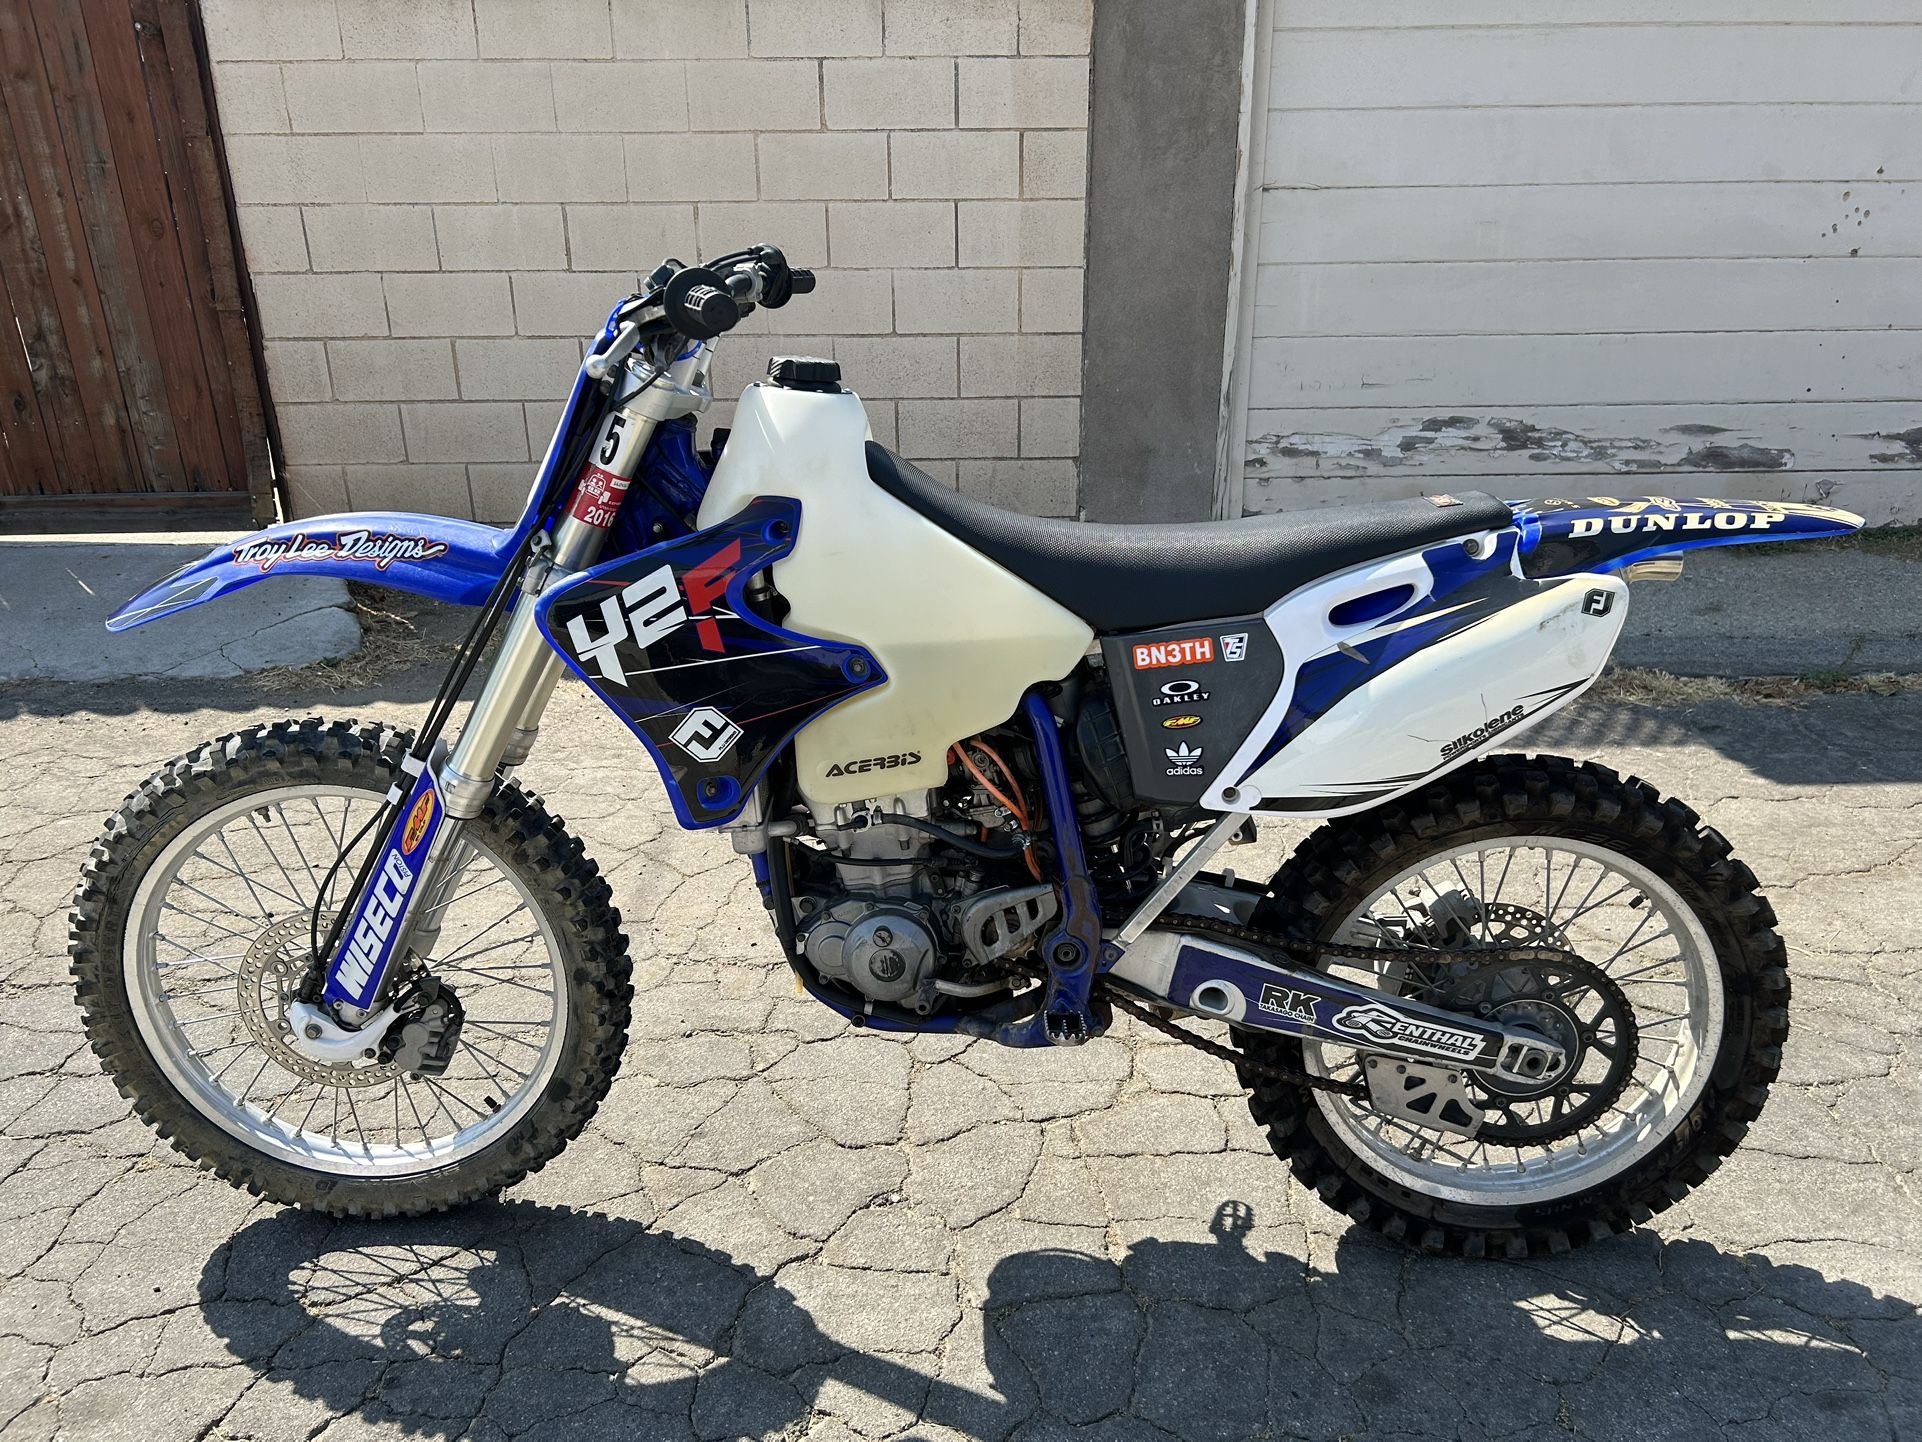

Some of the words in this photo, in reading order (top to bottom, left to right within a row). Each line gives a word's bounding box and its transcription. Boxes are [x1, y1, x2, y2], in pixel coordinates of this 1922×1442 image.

[600, 414, 626, 466] 5
[583, 506, 616, 527] 2016
[1567, 512, 1786, 539] DUNLOP
[235, 536, 285, 570] Troy
[285, 533, 334, 560] Lee
[337, 530, 446, 569] Designs
[1135, 640, 1211, 667] BN3TH
[1152, 692, 1210, 706] OAKLEY
[1440, 704, 1524, 757] Silkolene
[1166, 765, 1204, 777] adidas
[391, 852, 412, 878] PISTON
[335, 852, 413, 1001] WISECO
[1259, 1002, 1293, 1019] TAKASAGO
[1294, 1010, 1315, 1023] CHAIN
[1261, 982, 1322, 1017] RK
[1346, 1009, 1485, 1050] RENTHAL
[1399, 1034, 1472, 1057] CHAINWHEELS
